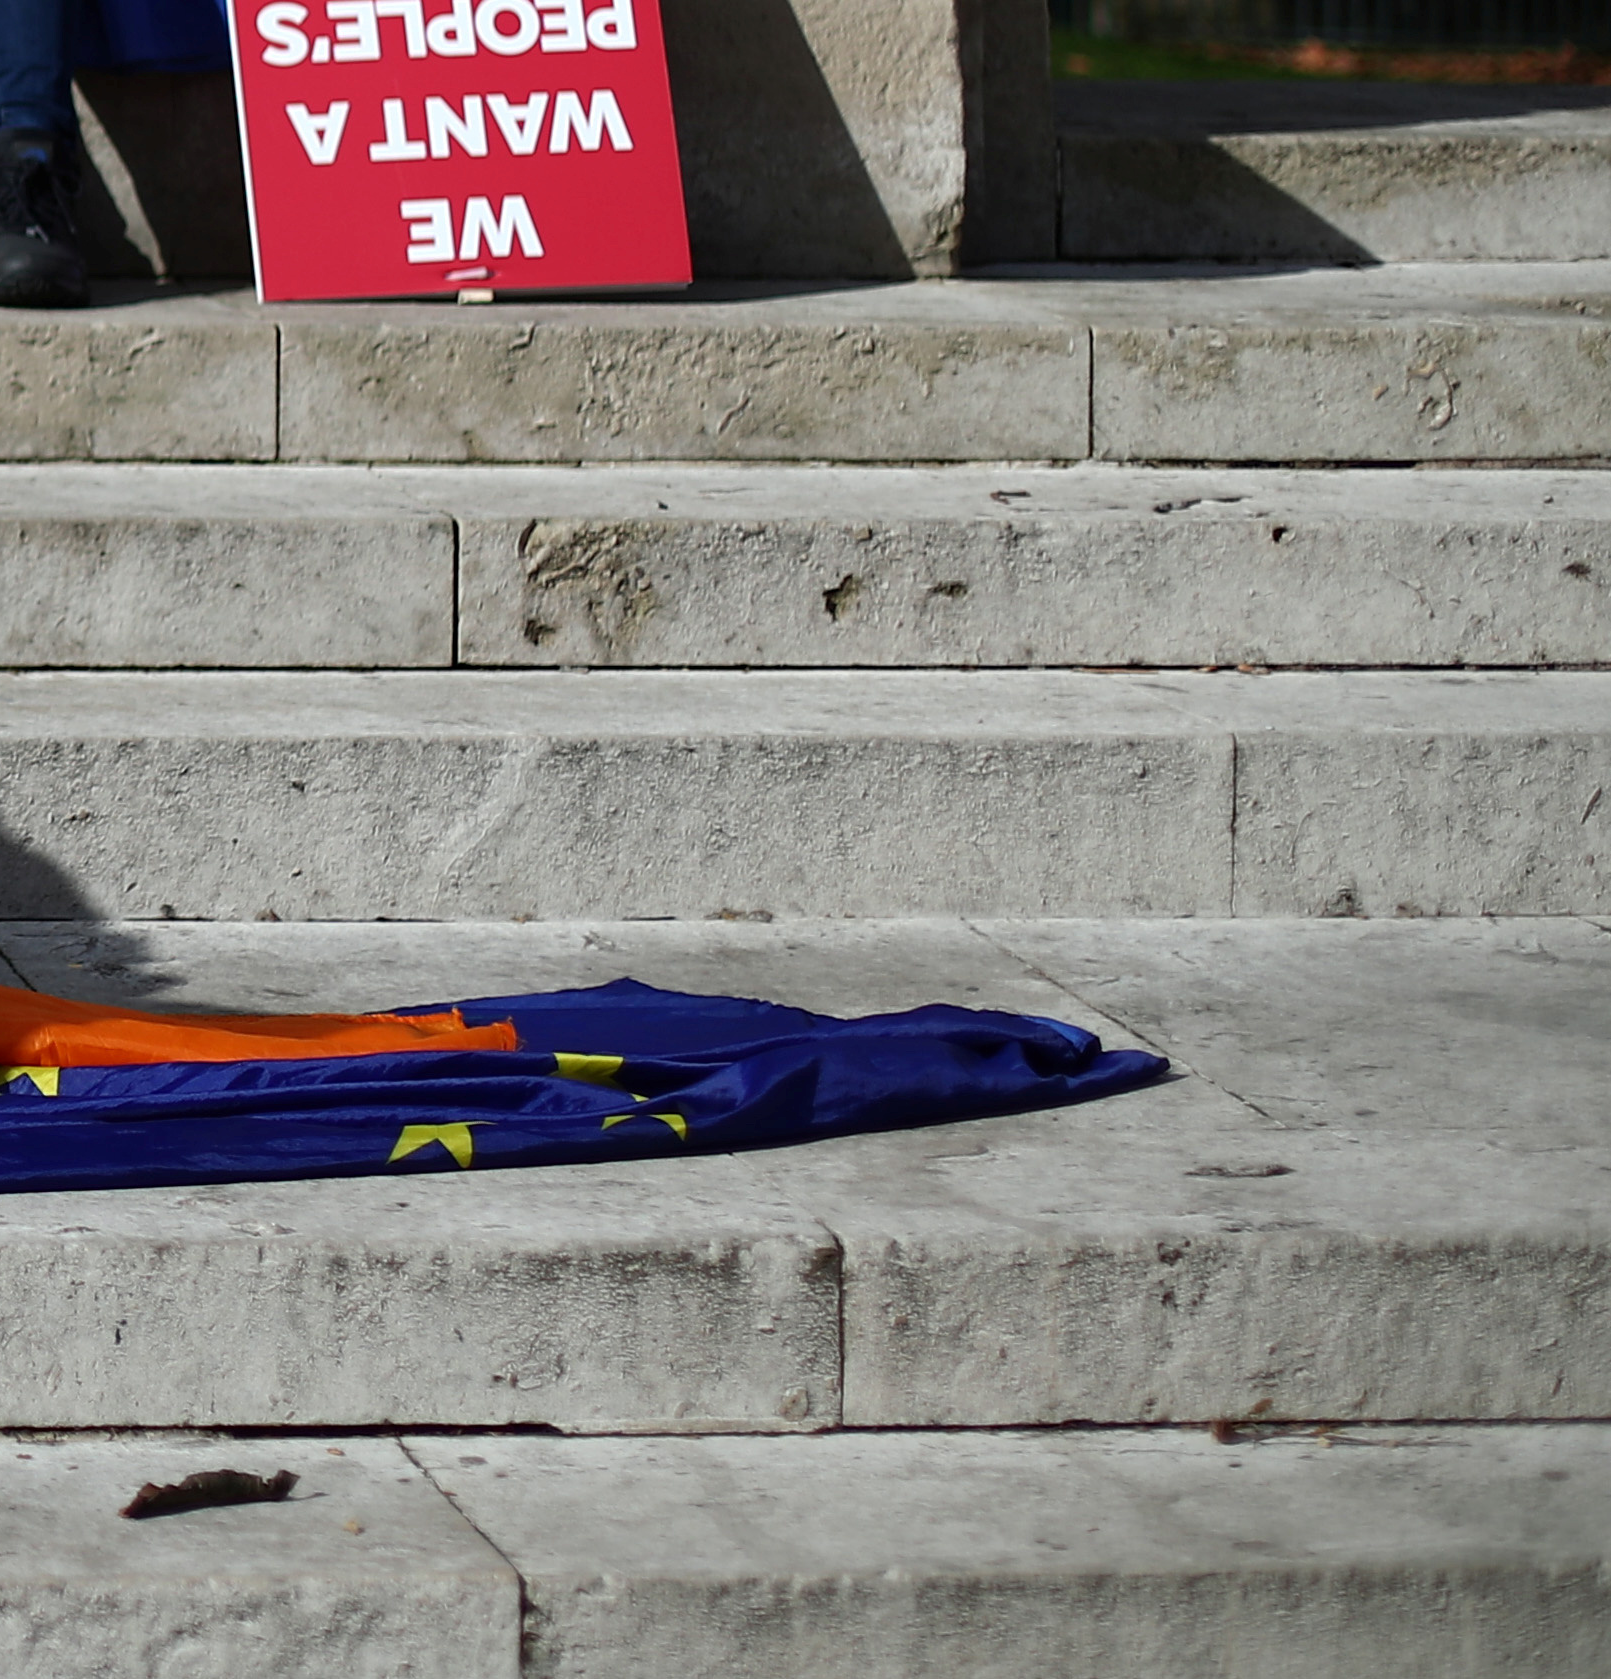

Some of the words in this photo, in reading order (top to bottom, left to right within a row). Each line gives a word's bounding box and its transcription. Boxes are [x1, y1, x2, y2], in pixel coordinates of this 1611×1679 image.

[285, 101, 350, 165] A
[369, 89, 633, 162] WANT
[400, 194, 545, 264] WE
